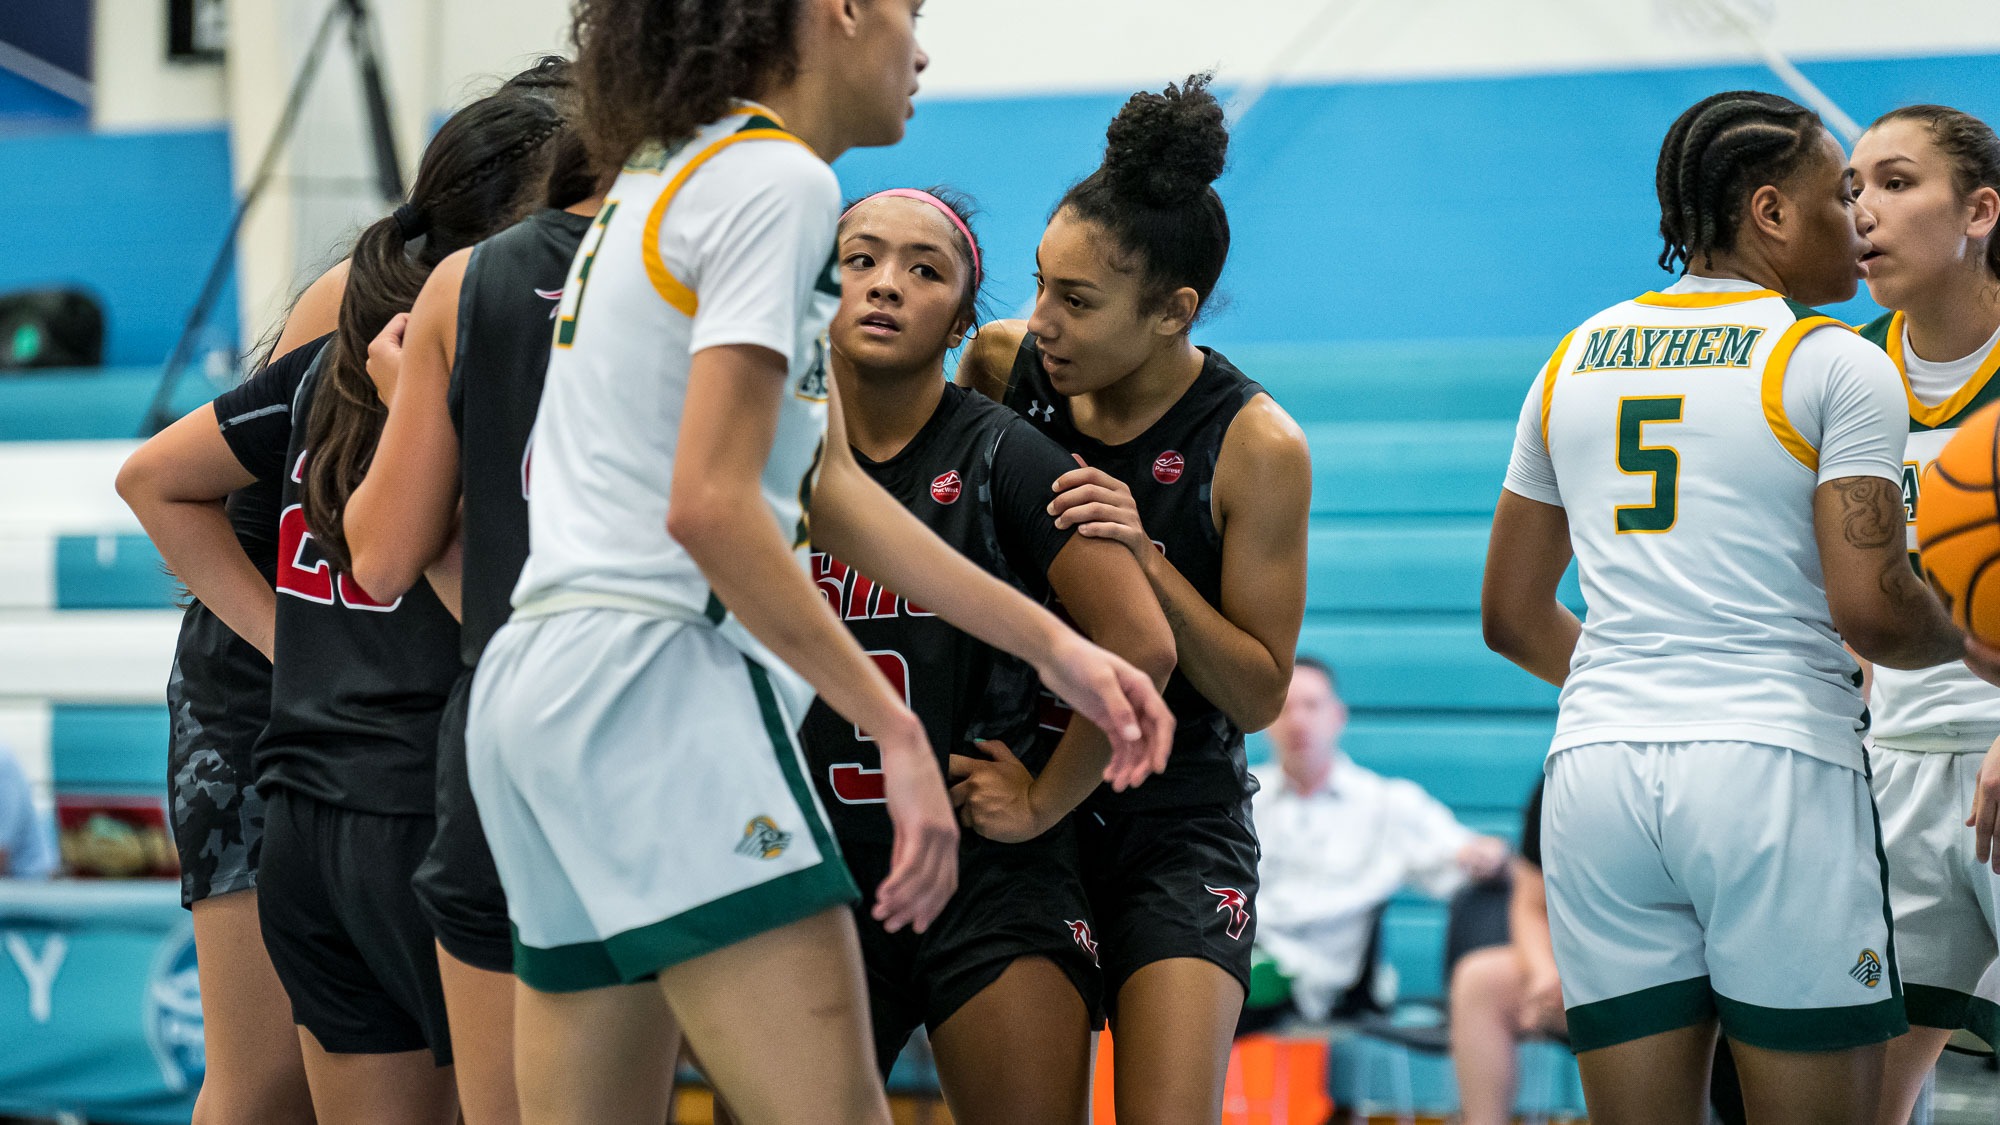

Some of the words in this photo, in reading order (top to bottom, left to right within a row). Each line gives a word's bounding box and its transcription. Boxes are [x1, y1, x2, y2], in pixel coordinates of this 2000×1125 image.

[1572, 323, 1768, 375] MAYHEM
[1614, 395, 1686, 535] 5
[276, 502, 402, 612] 2
[5, 931, 68, 1024] Y
